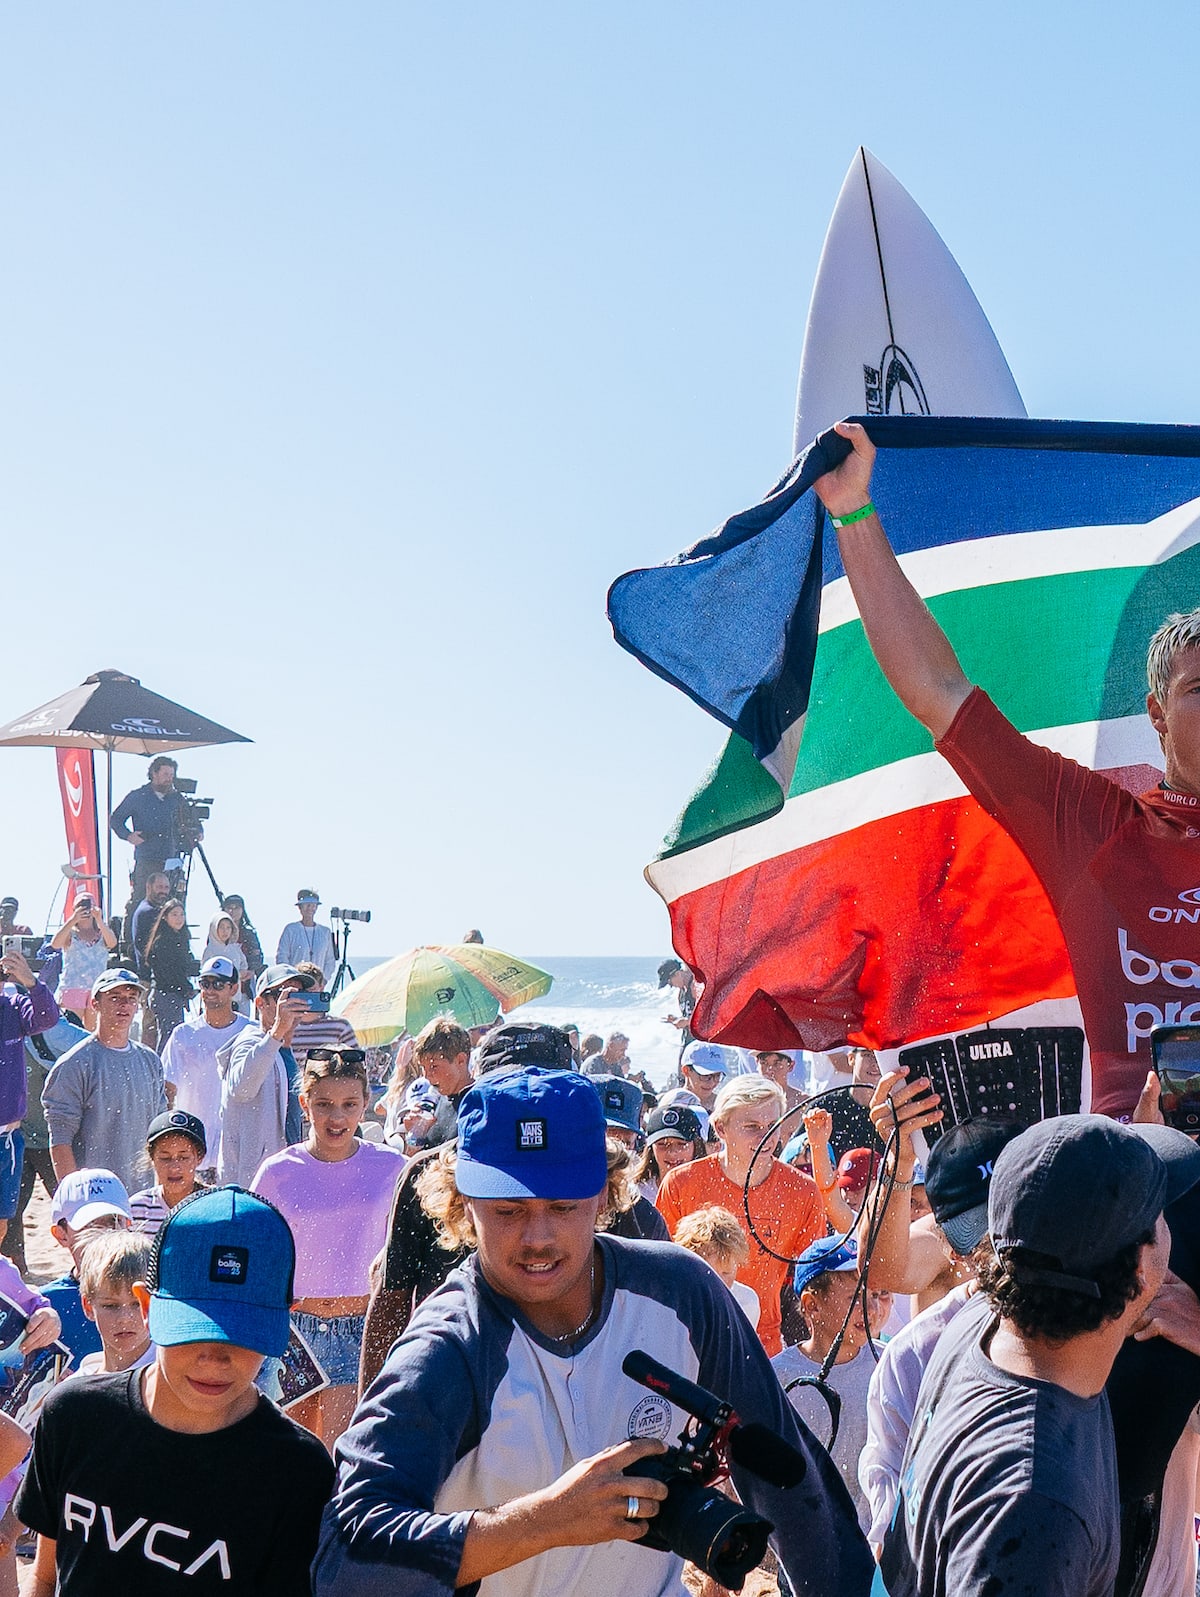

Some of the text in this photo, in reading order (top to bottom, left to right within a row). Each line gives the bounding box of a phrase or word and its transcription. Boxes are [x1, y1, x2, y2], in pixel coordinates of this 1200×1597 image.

[110, 723, 191, 736] O'NEILL
[1163, 790, 1198, 807] WORLD
[969, 1040, 1013, 1061] ULTRA
[520, 1121, 543, 1136] VANS
[217, 1259, 242, 1270] ballito
[637, 1411, 663, 1428] VANS
[64, 1493, 231, 1580] RVCA
